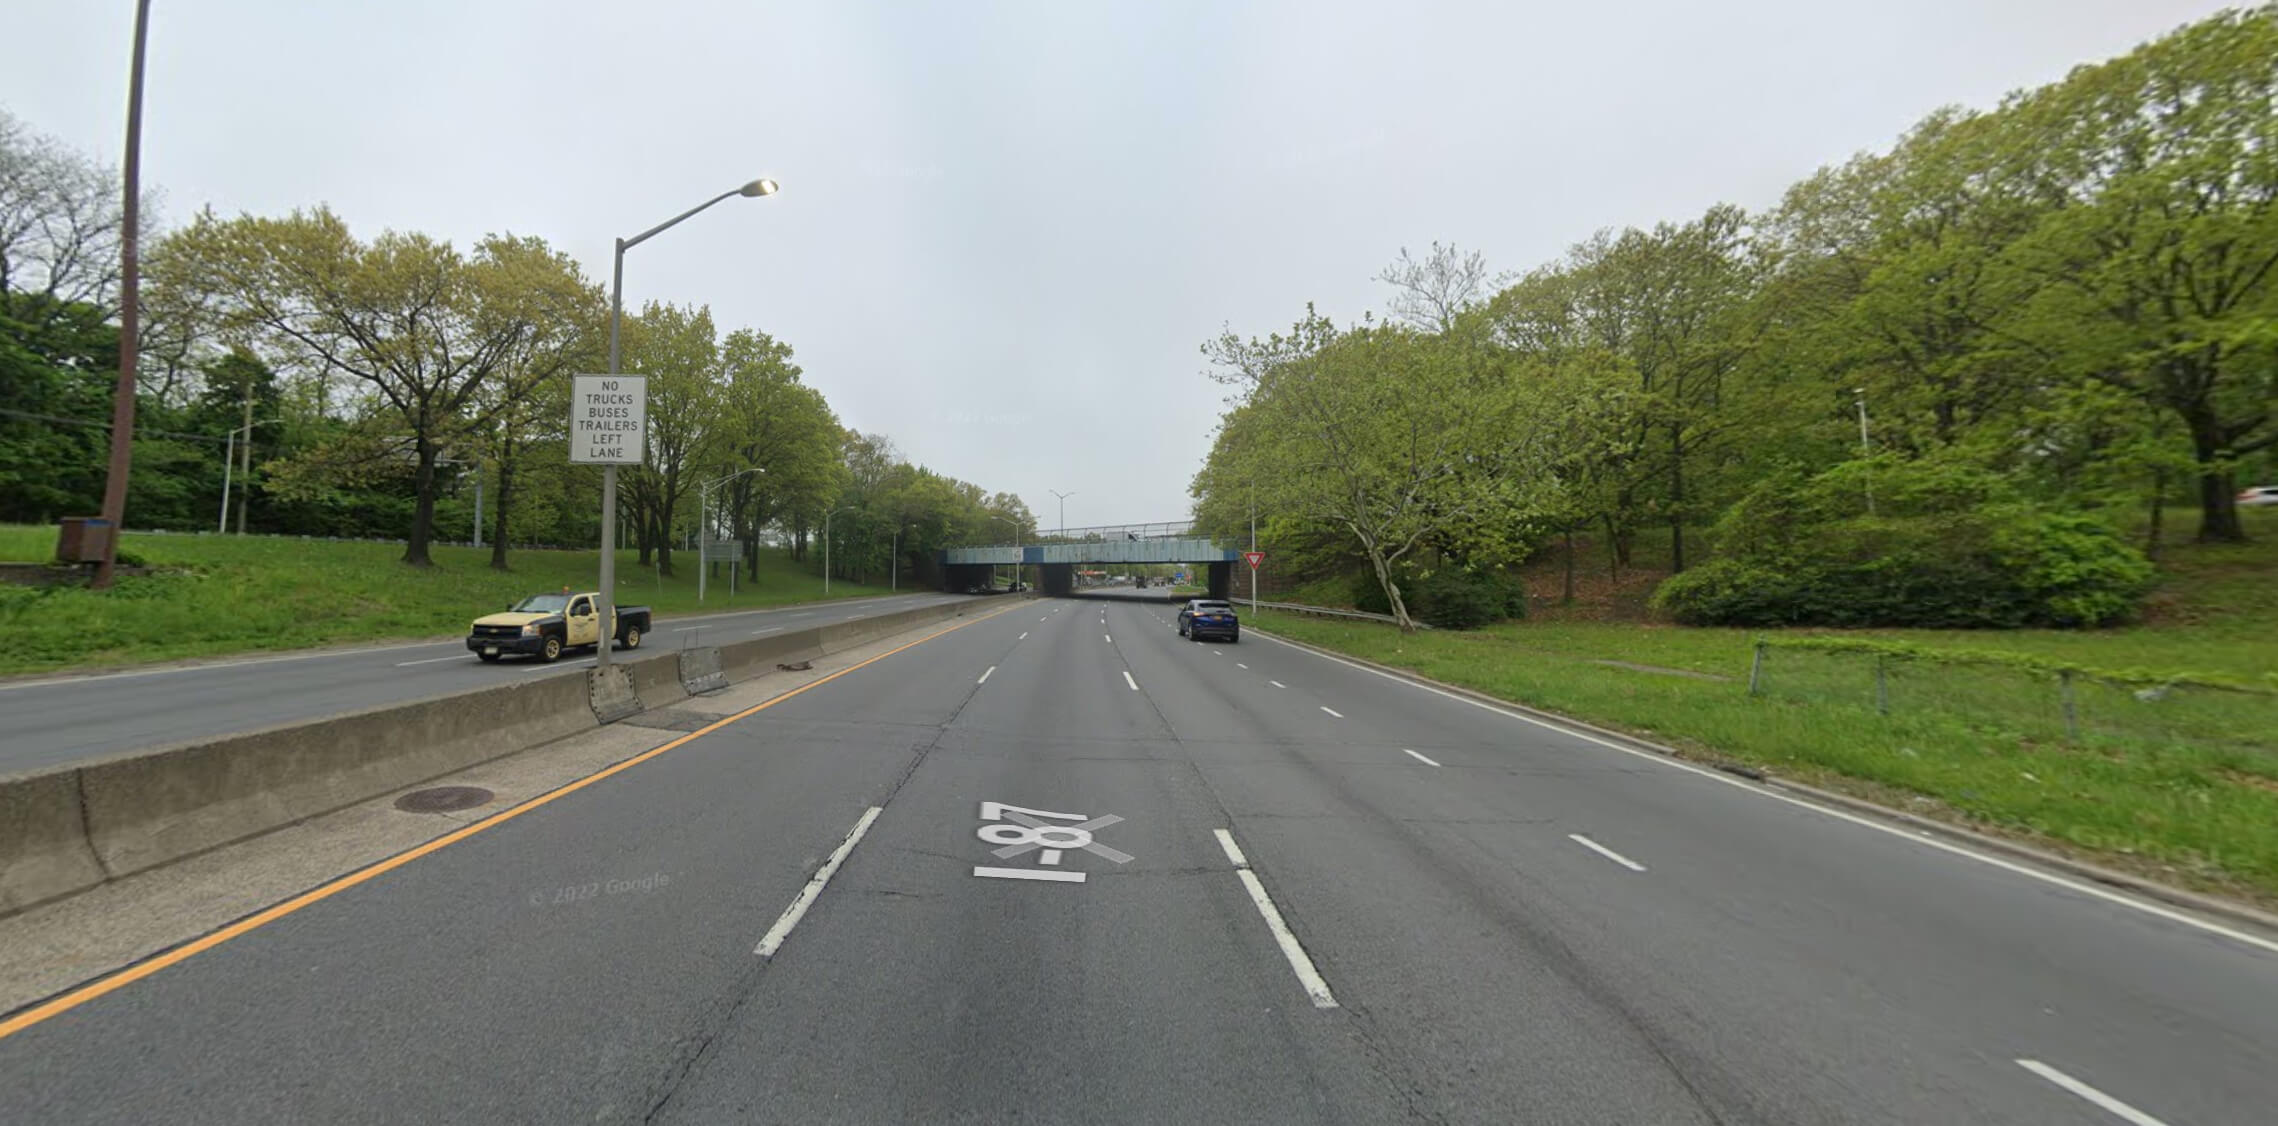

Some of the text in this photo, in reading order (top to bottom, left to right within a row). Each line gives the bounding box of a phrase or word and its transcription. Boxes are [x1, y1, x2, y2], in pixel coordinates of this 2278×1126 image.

[601, 381, 619, 391] NO
[586, 394, 633, 405] TRUCKS
[589, 407, 629, 418] BUSES
[579, 420, 638, 431] TRAILERS
[592, 434, 622, 444] LEFT
[590, 447, 624, 458] LANE
